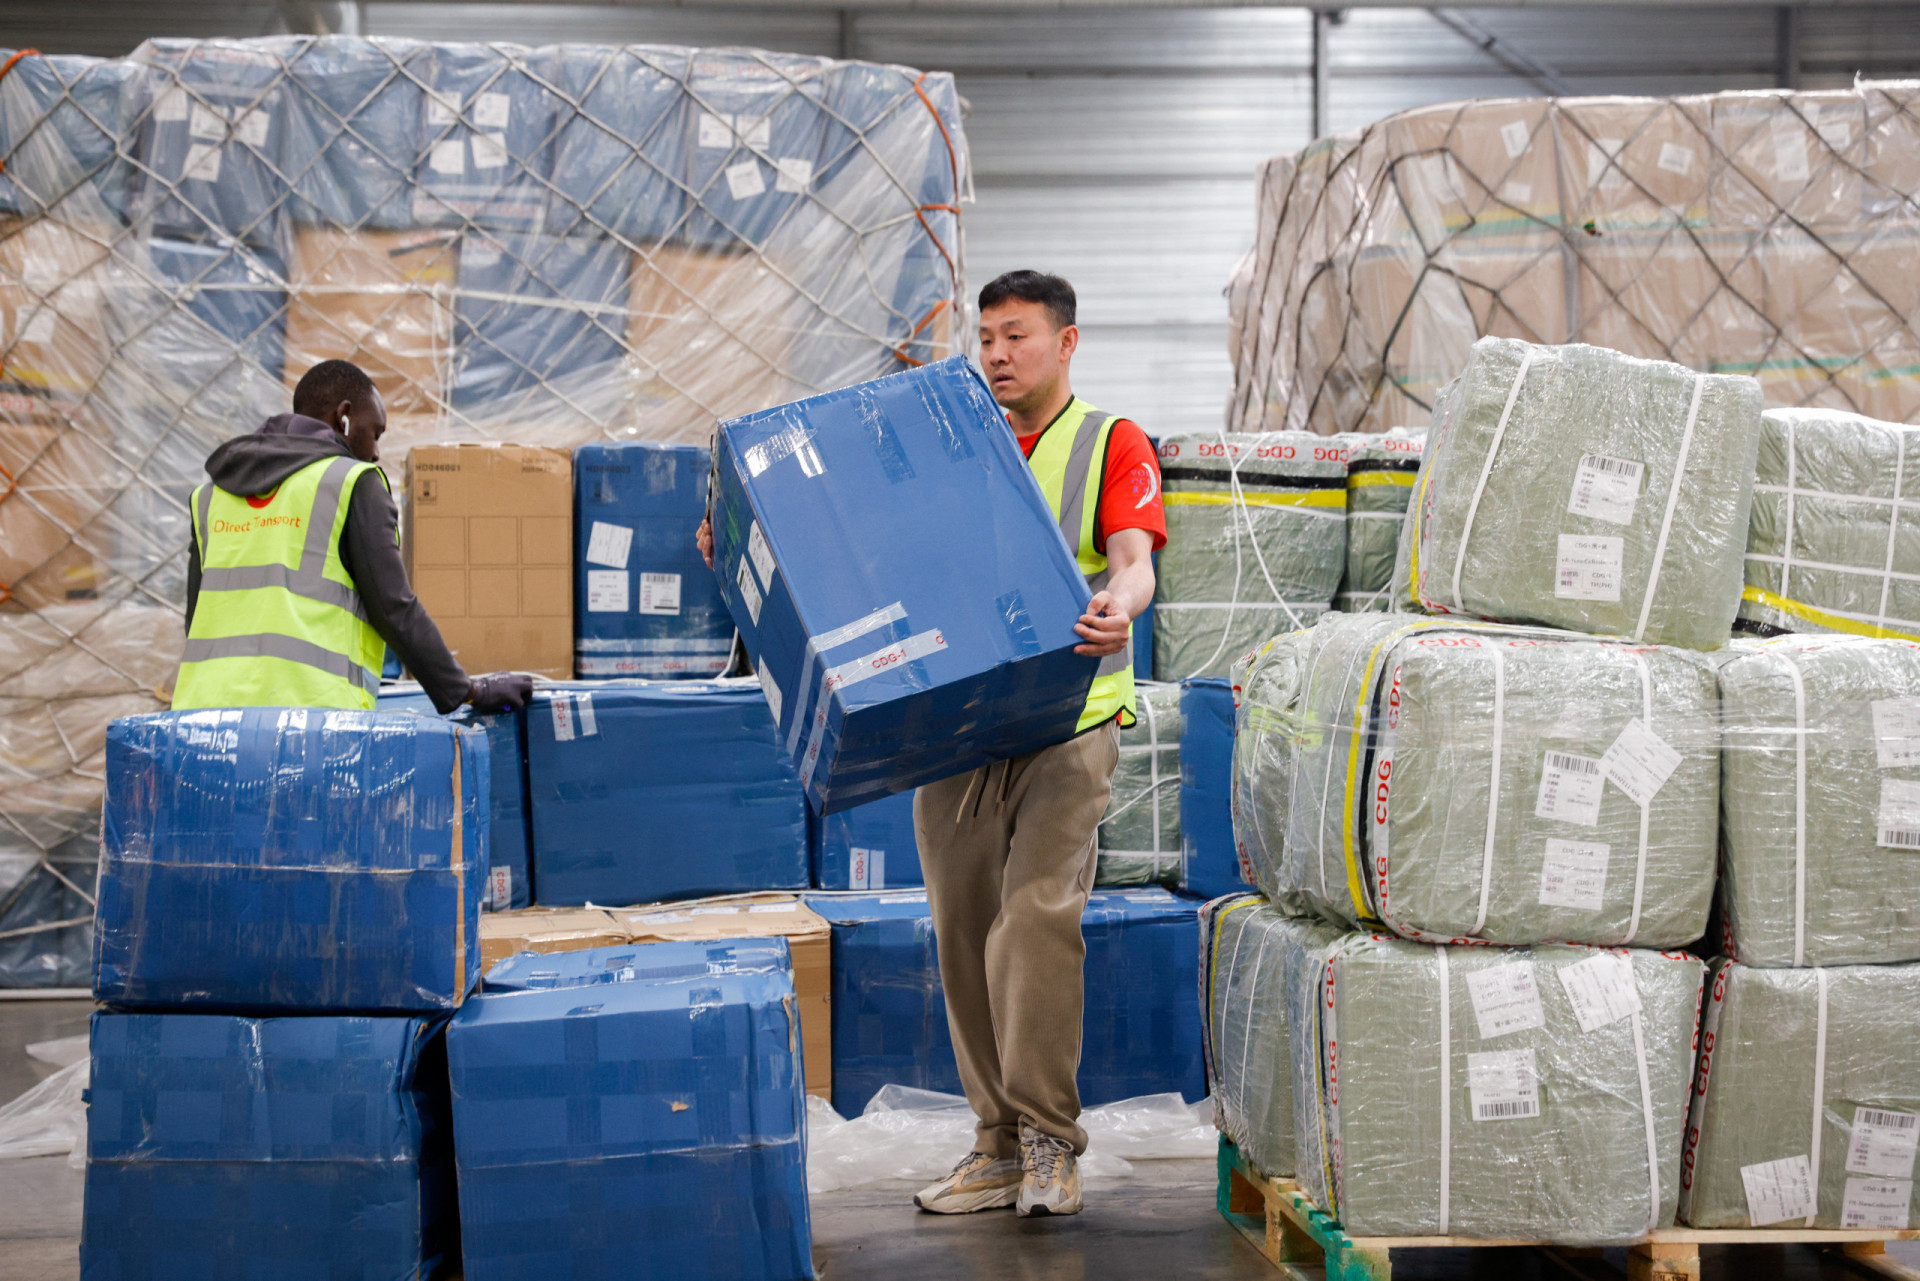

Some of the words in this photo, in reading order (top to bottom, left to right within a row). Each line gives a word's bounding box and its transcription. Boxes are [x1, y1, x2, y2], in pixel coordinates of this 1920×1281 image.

[1159, 443, 1181, 458] CD
[1198, 443, 1239, 458] CDG
[1256, 445, 1297, 460] CDG
[213, 519, 251, 533] Direct
[253, 514, 301, 529] Transport
[1417, 637, 1482, 648] CDG
[615, 662, 643, 671] CDG-1
[663, 661, 688, 670] CDG-1
[871, 648, 907, 669] CDG-1
[1375, 759, 1392, 825] CDG
[855, 852, 865, 881] CDG-1
[496, 871, 506, 900] CDG-1
[1328, 1040, 1339, 1107] CDG
[1697, 1030, 1715, 1097] CDG
[1682, 1126, 1700, 1191] CDG
